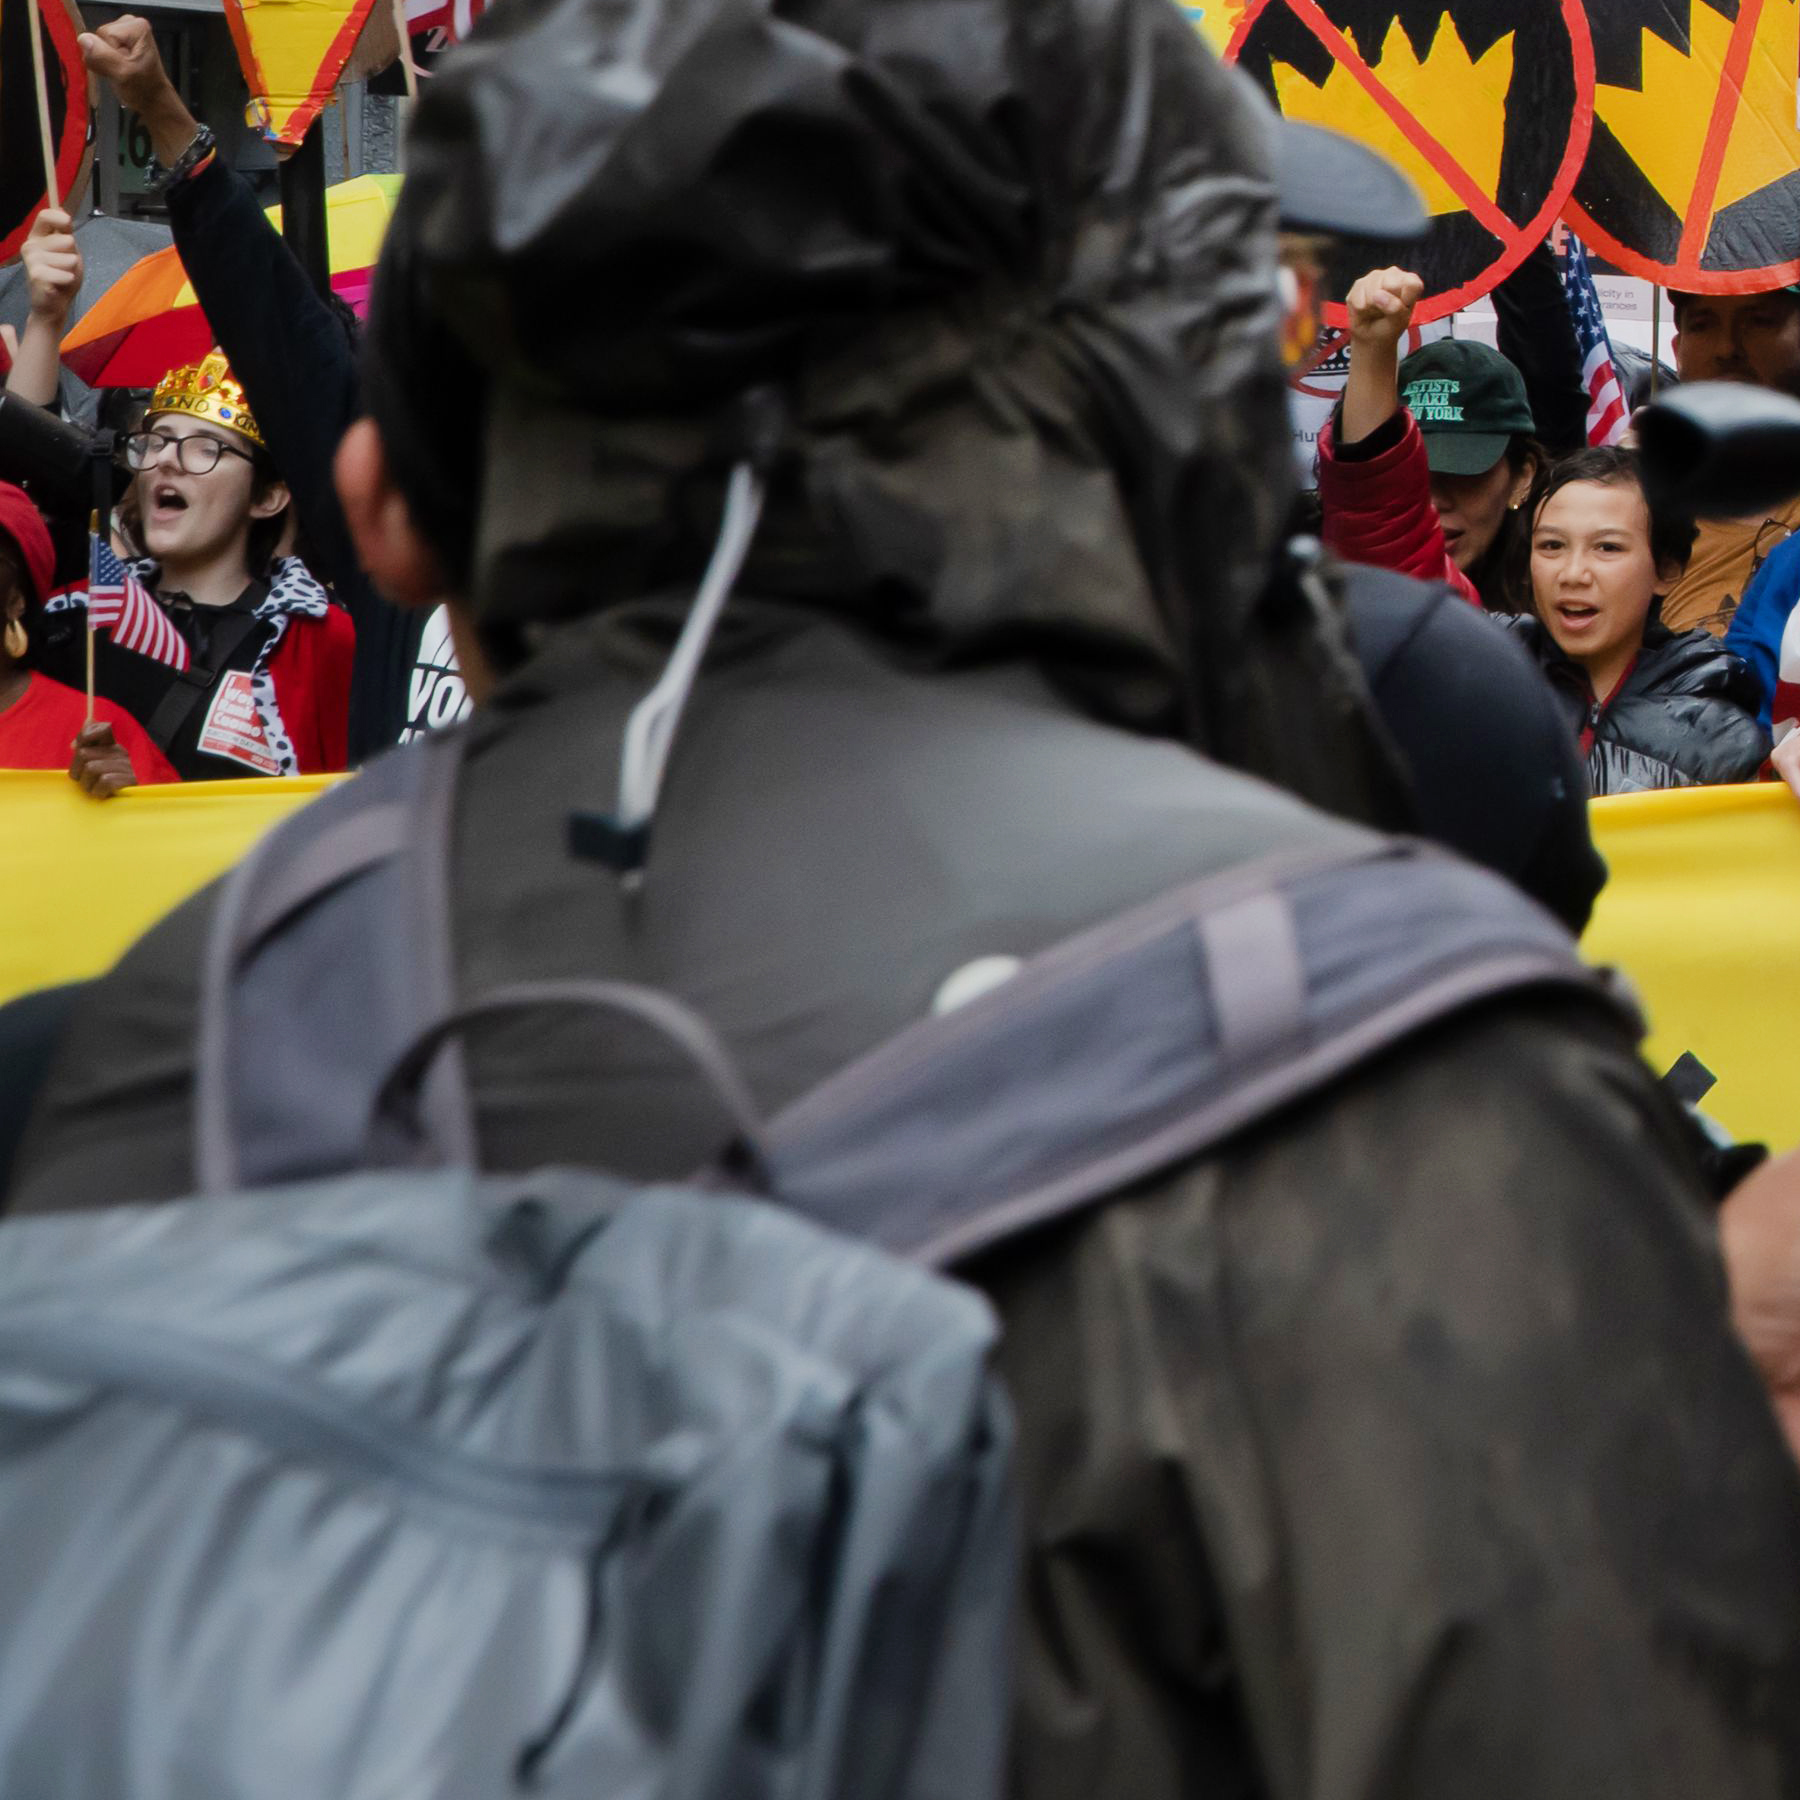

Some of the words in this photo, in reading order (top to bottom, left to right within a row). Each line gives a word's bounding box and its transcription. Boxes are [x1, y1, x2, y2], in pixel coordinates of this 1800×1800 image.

[178, 395, 208, 412] NO
[1408, 393, 1449, 406] MAKE
[1426, 407, 1464, 421] YORK
